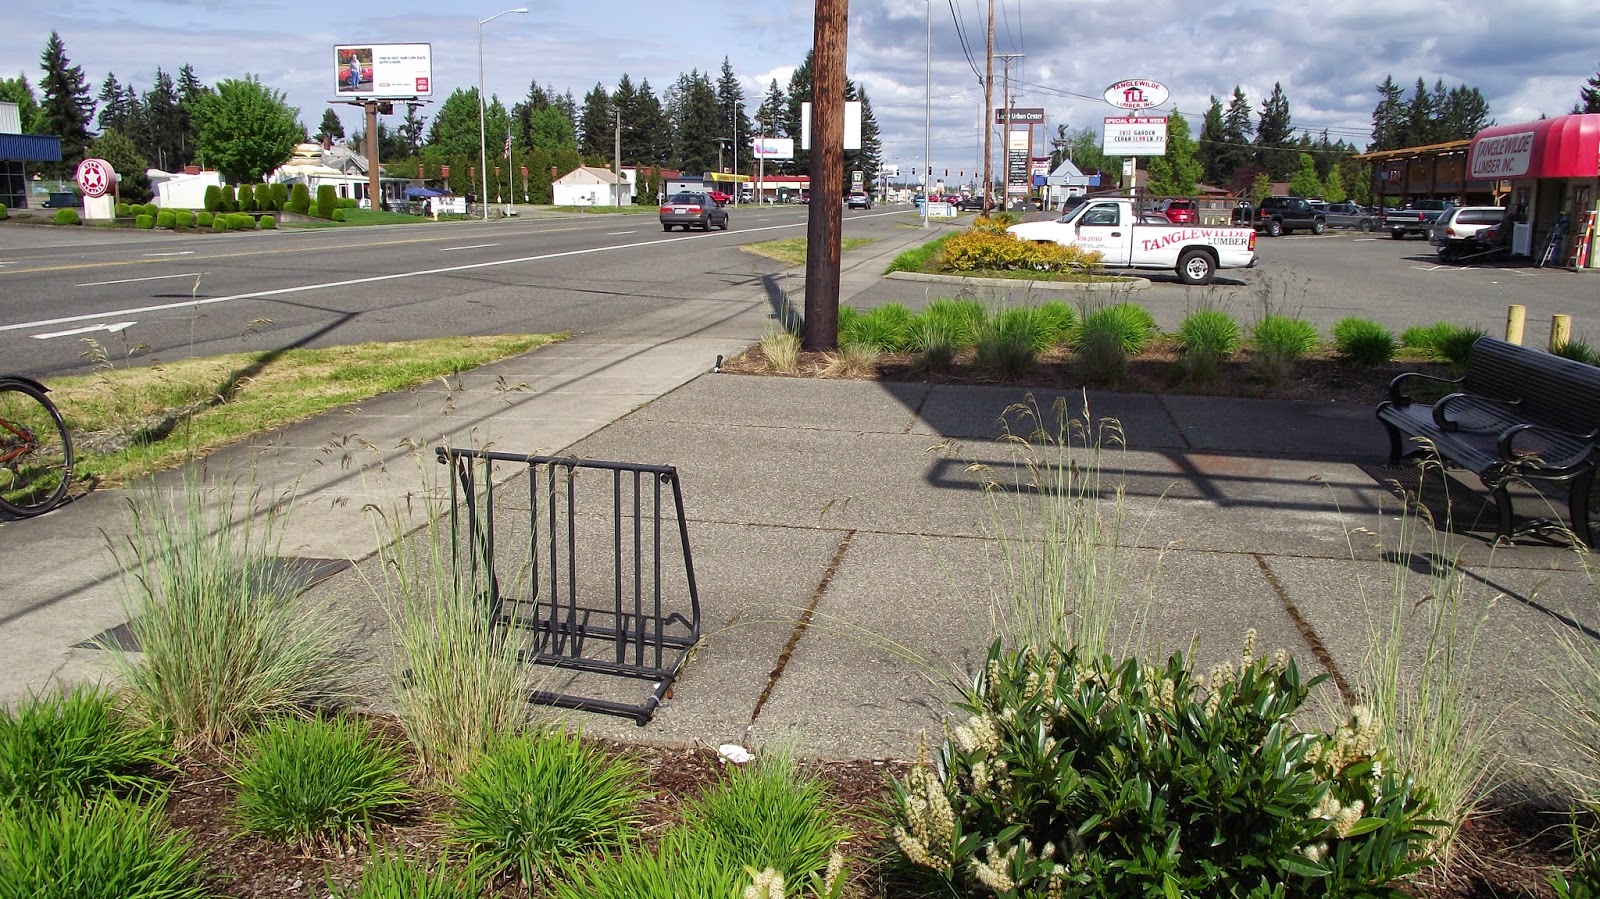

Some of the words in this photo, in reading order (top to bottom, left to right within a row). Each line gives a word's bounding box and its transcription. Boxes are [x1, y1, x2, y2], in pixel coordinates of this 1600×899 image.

[1112, 80, 1160, 90] TANGLEWILDE
[1478, 134, 1532, 157] TANGLEWILDE
[1474, 153, 1501, 174] LUMBER
[1142, 229, 1248, 251] TANGLEWILDE
